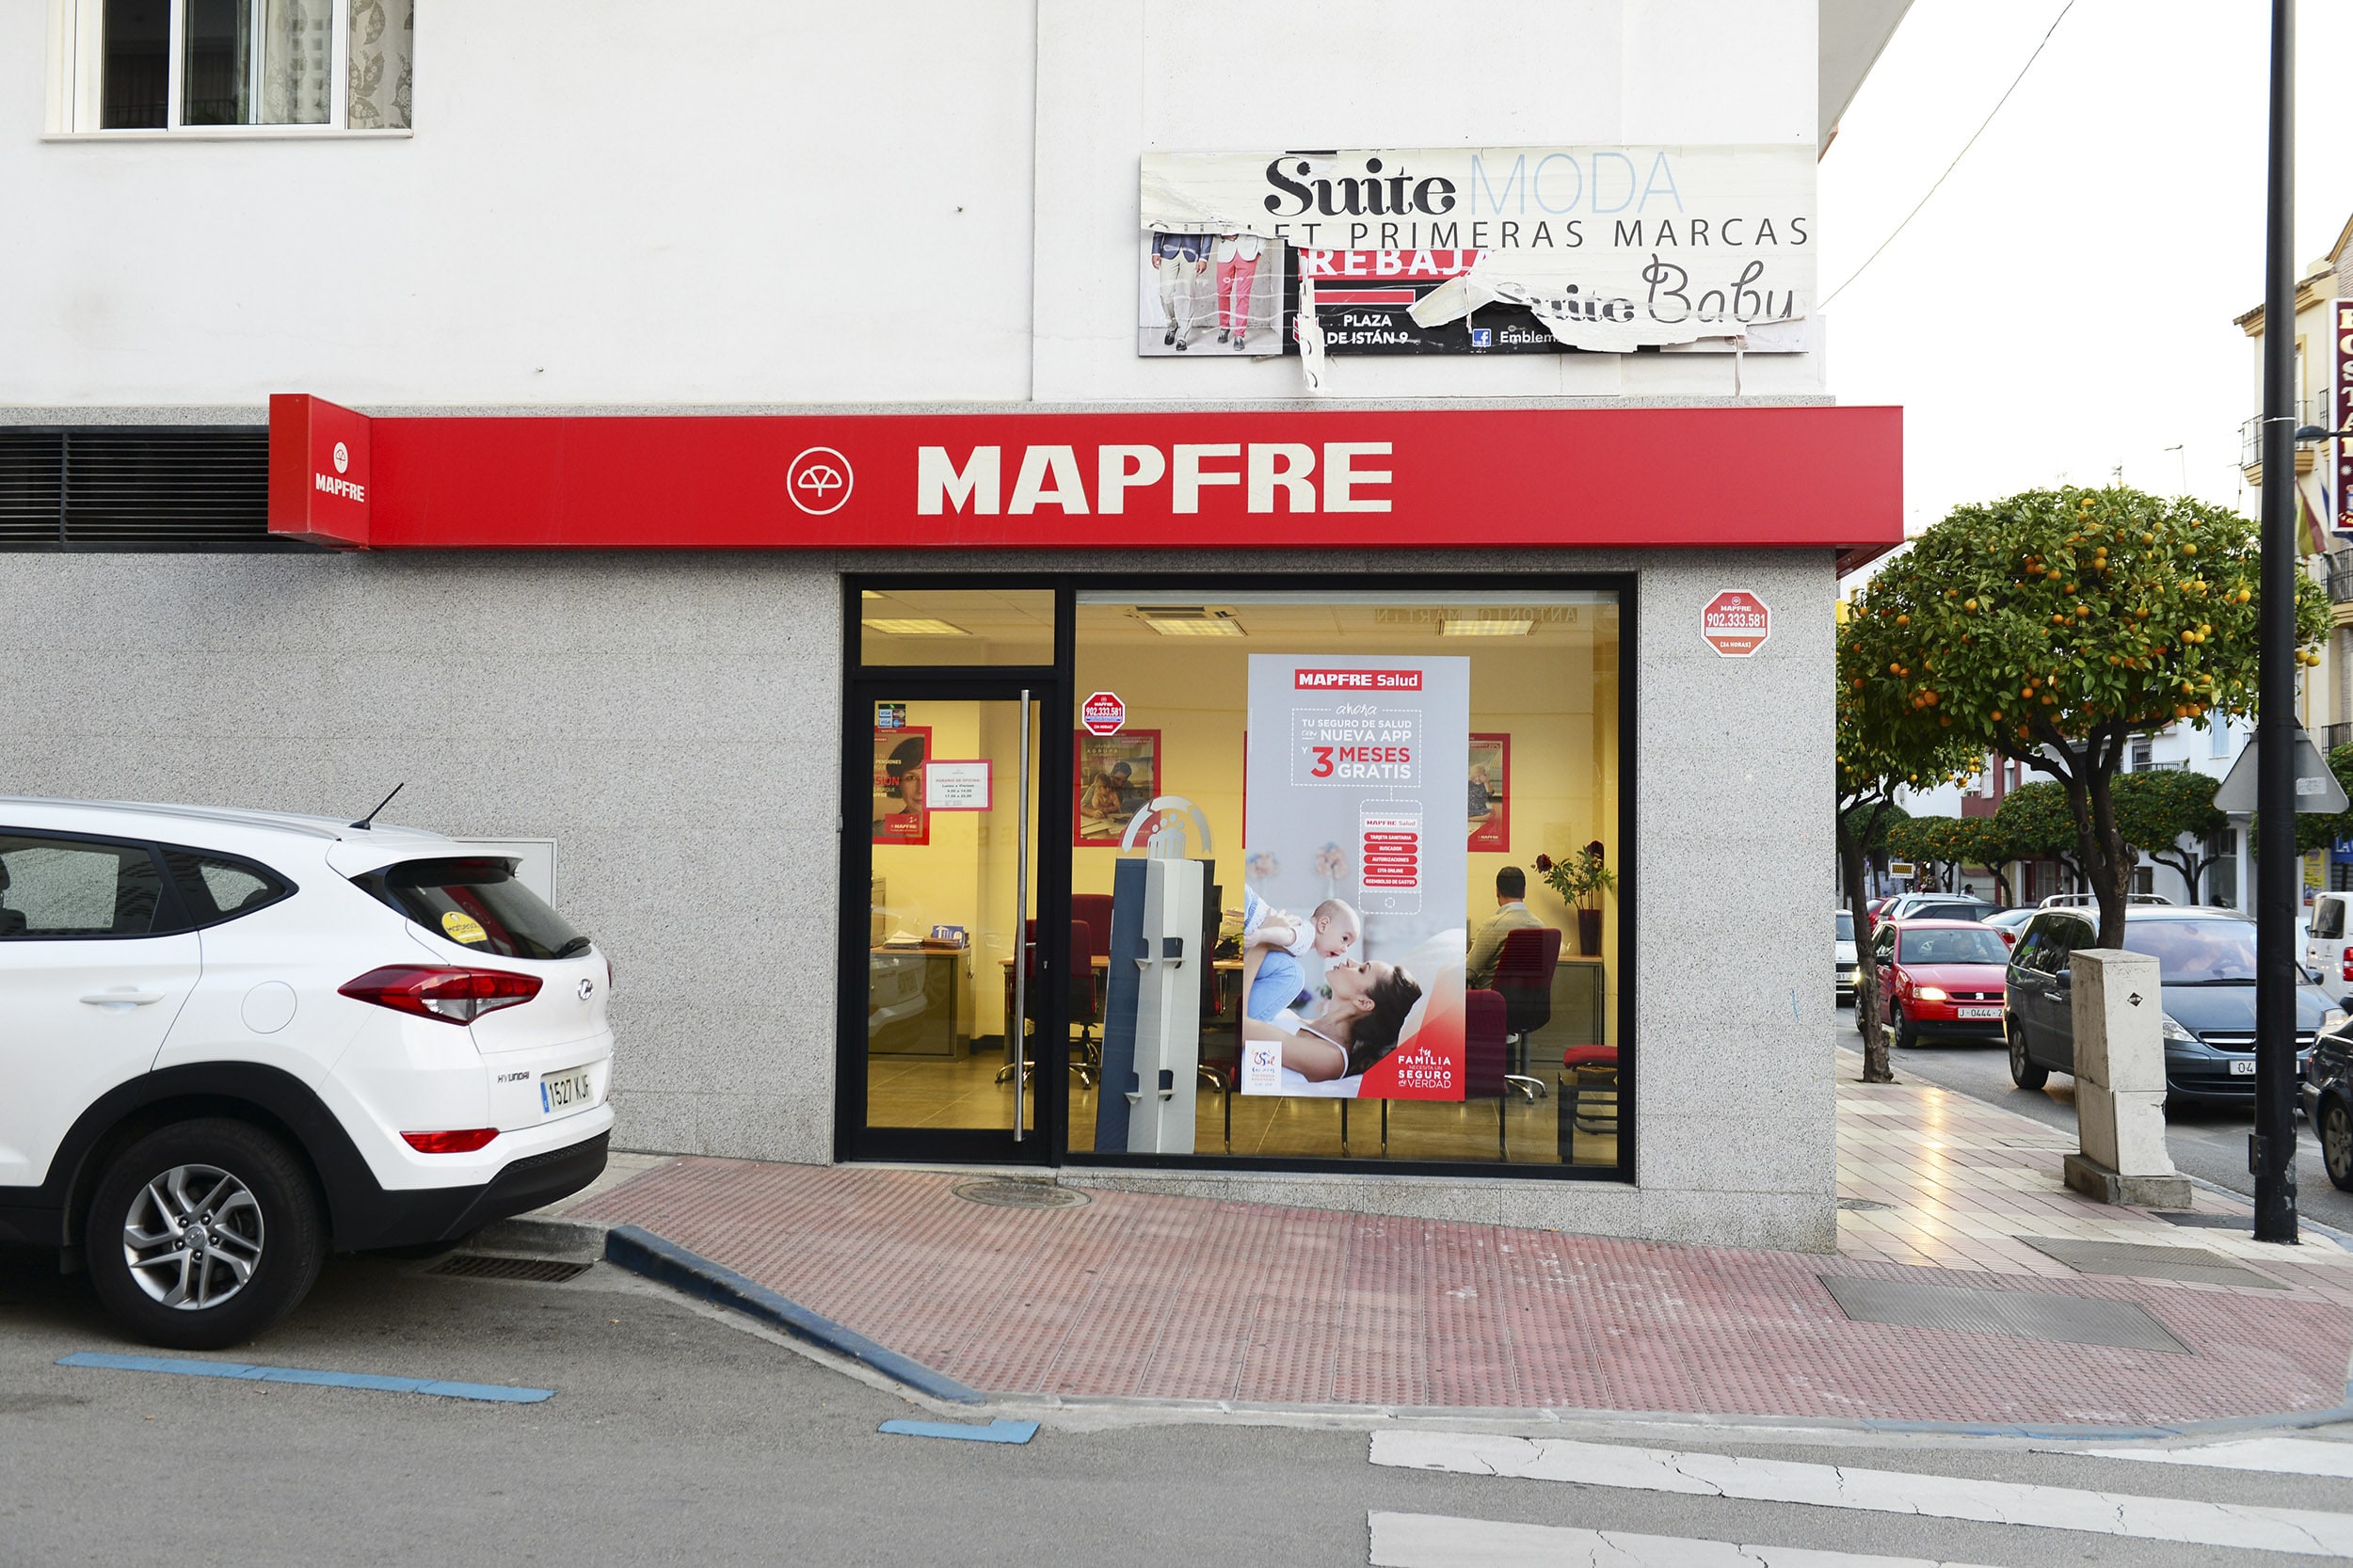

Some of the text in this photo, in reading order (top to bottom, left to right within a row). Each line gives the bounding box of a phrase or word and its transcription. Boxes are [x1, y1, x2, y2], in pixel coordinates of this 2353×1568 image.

[1264, 152, 1684, 216] Suite MODA
[1351, 220, 1584, 248] PRIMERAS
[1614, 217, 1808, 248] MARCAS
[1309, 248, 1495, 276] REBAJ
[1343, 314, 1393, 328] PLAZA
[1327, 329, 1409, 344] DE ISTÁN 9
[917, 441, 1393, 515] MAPFRE
[315, 472, 365, 503] MAPFRE
[1706, 613, 1766, 627] 902.333.581
[1299, 673, 1418, 686] MAPFRE Salud
[1086, 707, 1122, 716] 902.333.581
[1336, 703, 1378, 716] ahora
[1302, 719, 1412, 728] TU SEGURO DE SALUD
[1321, 729, 1375, 742] NUEVA
[1380, 729, 1412, 742] APP
[1310, 746, 1334, 777] 3
[1339, 746, 1411, 762] MESES
[1337, 763, 1412, 778] GRATIS
[1398, 1055, 1451, 1065] FAMILIA
[497, 1071, 530, 1083] HYUNDAI
[1398, 1069, 1451, 1080] SEGURO
[1407, 1079, 1451, 1089] VERDAD
[549, 1079, 572, 1107] 1527
